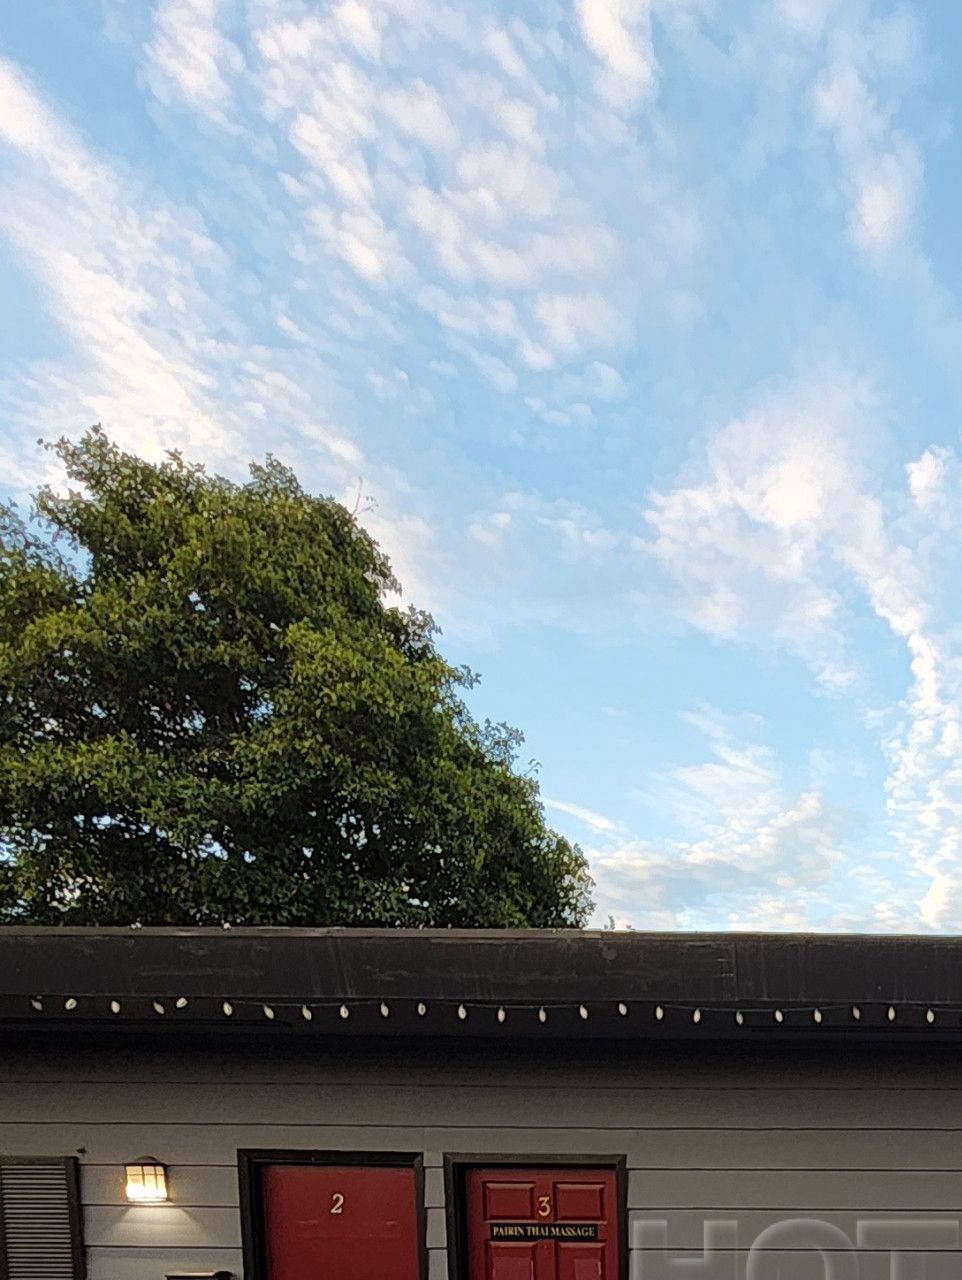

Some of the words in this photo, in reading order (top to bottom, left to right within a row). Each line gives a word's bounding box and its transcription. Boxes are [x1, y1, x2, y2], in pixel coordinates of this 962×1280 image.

[331, 1193, 344, 1213] 2
[538, 1196, 551, 1217] 3
[493, 1226, 525, 1237] PAIRIN
[526, 1226, 549, 1237] THAI
[550, 1226, 595, 1237] MASSAGE
